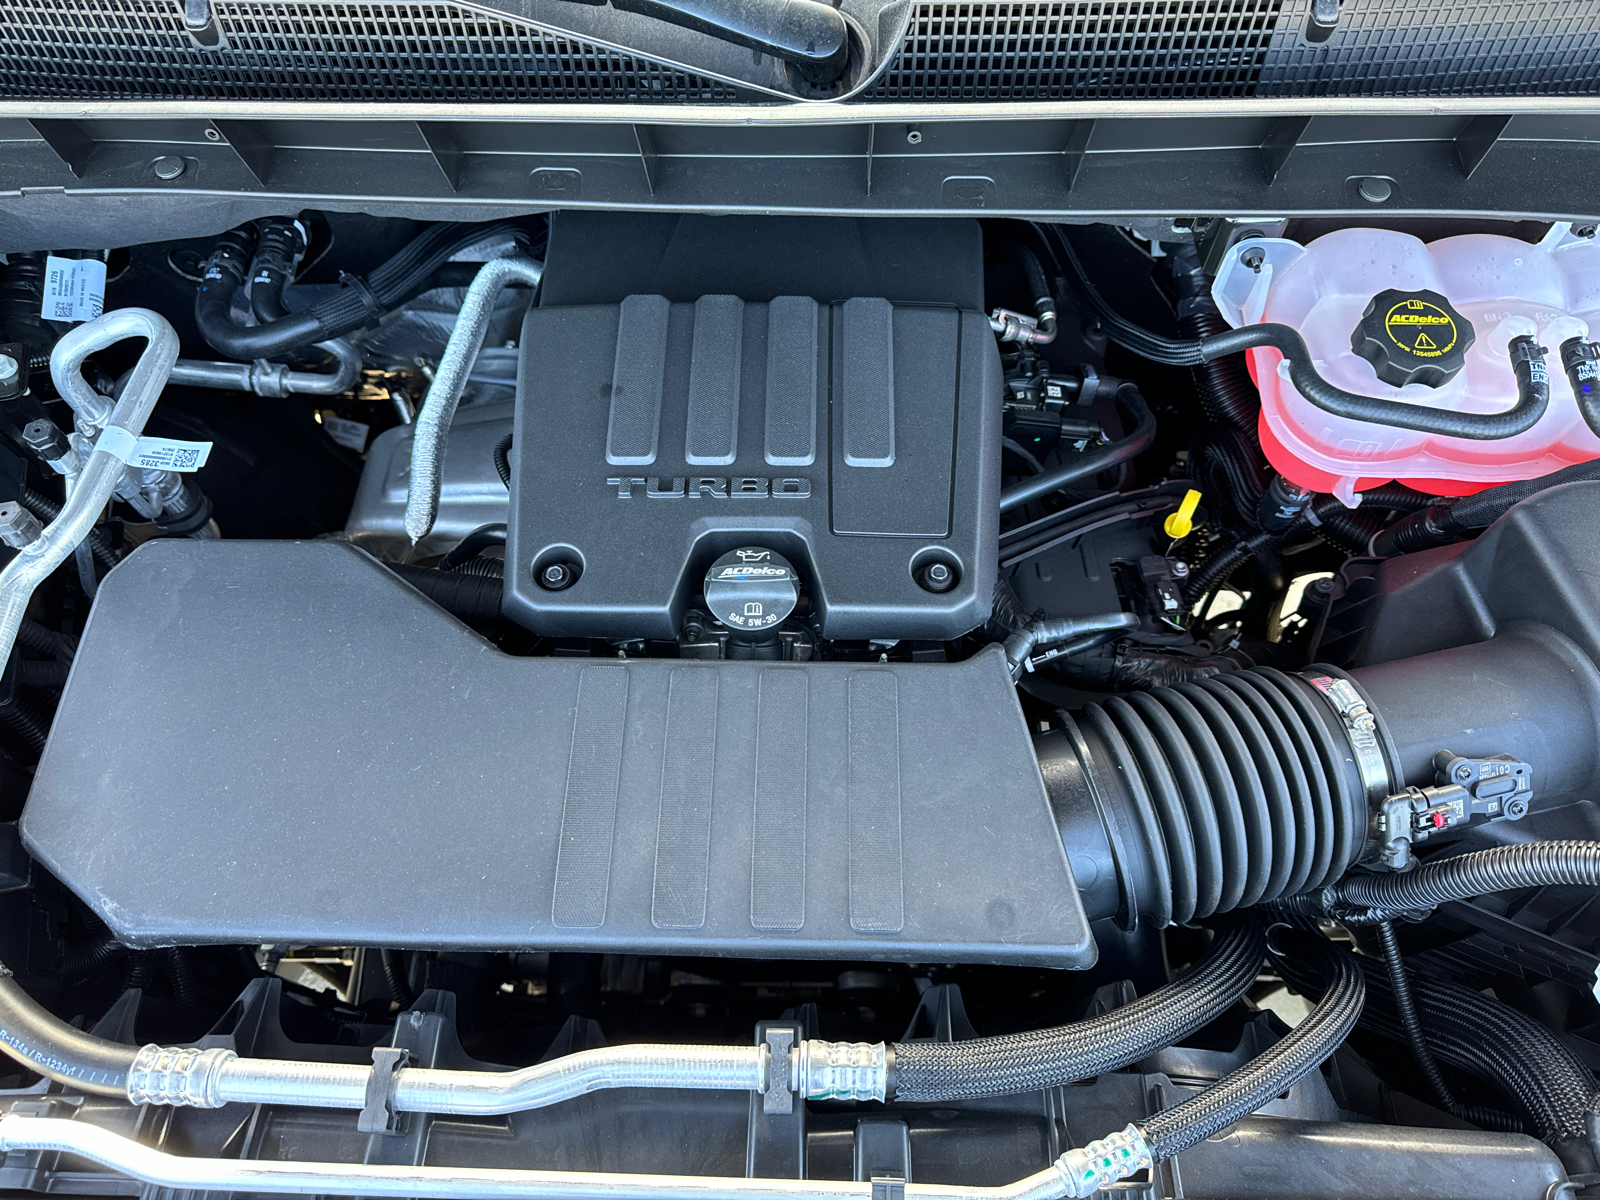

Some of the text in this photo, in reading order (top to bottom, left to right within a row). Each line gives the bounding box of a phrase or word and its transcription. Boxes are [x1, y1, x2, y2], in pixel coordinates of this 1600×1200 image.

[50, 270, 58, 284] 9726
[1389, 314, 1450, 324] ACDelco
[140, 459, 160, 468] 3285
[606, 477, 812, 499] TURBO
[720, 566, 786, 577] ACDelco
[728, 612, 778, 627] SAE 5W-30
[0, 1029, 28, 1055] R-134a
[34, 1051, 76, 1076] R-1234yf
